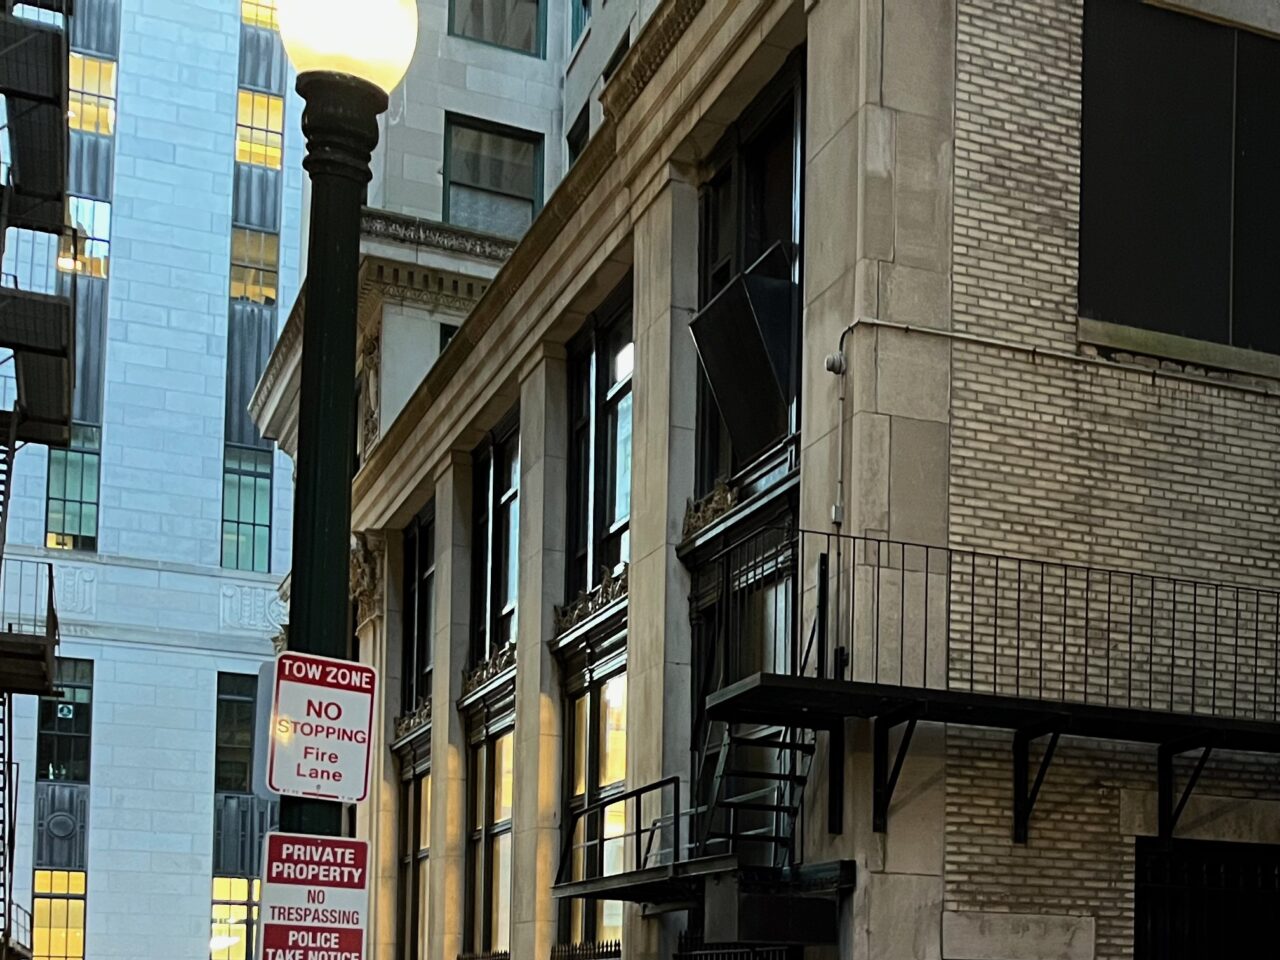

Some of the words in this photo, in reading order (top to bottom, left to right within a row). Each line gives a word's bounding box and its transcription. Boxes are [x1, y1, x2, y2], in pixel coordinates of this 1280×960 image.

[282, 658, 323, 682] TOW
[326, 667, 373, 689] ZONE
[306, 699, 343, 721] NO
[277, 719, 368, 744] STOPPING
[303, 746, 340, 764] Fire
[296, 763, 344, 783] Lane
[282, 843, 356, 865] PRIVATE
[271, 862, 363, 884] PROPERTY
[306, 889, 326, 905] NO
[269, 906, 360, 926] TRESPASSING
[288, 930, 340, 949] POLICE
